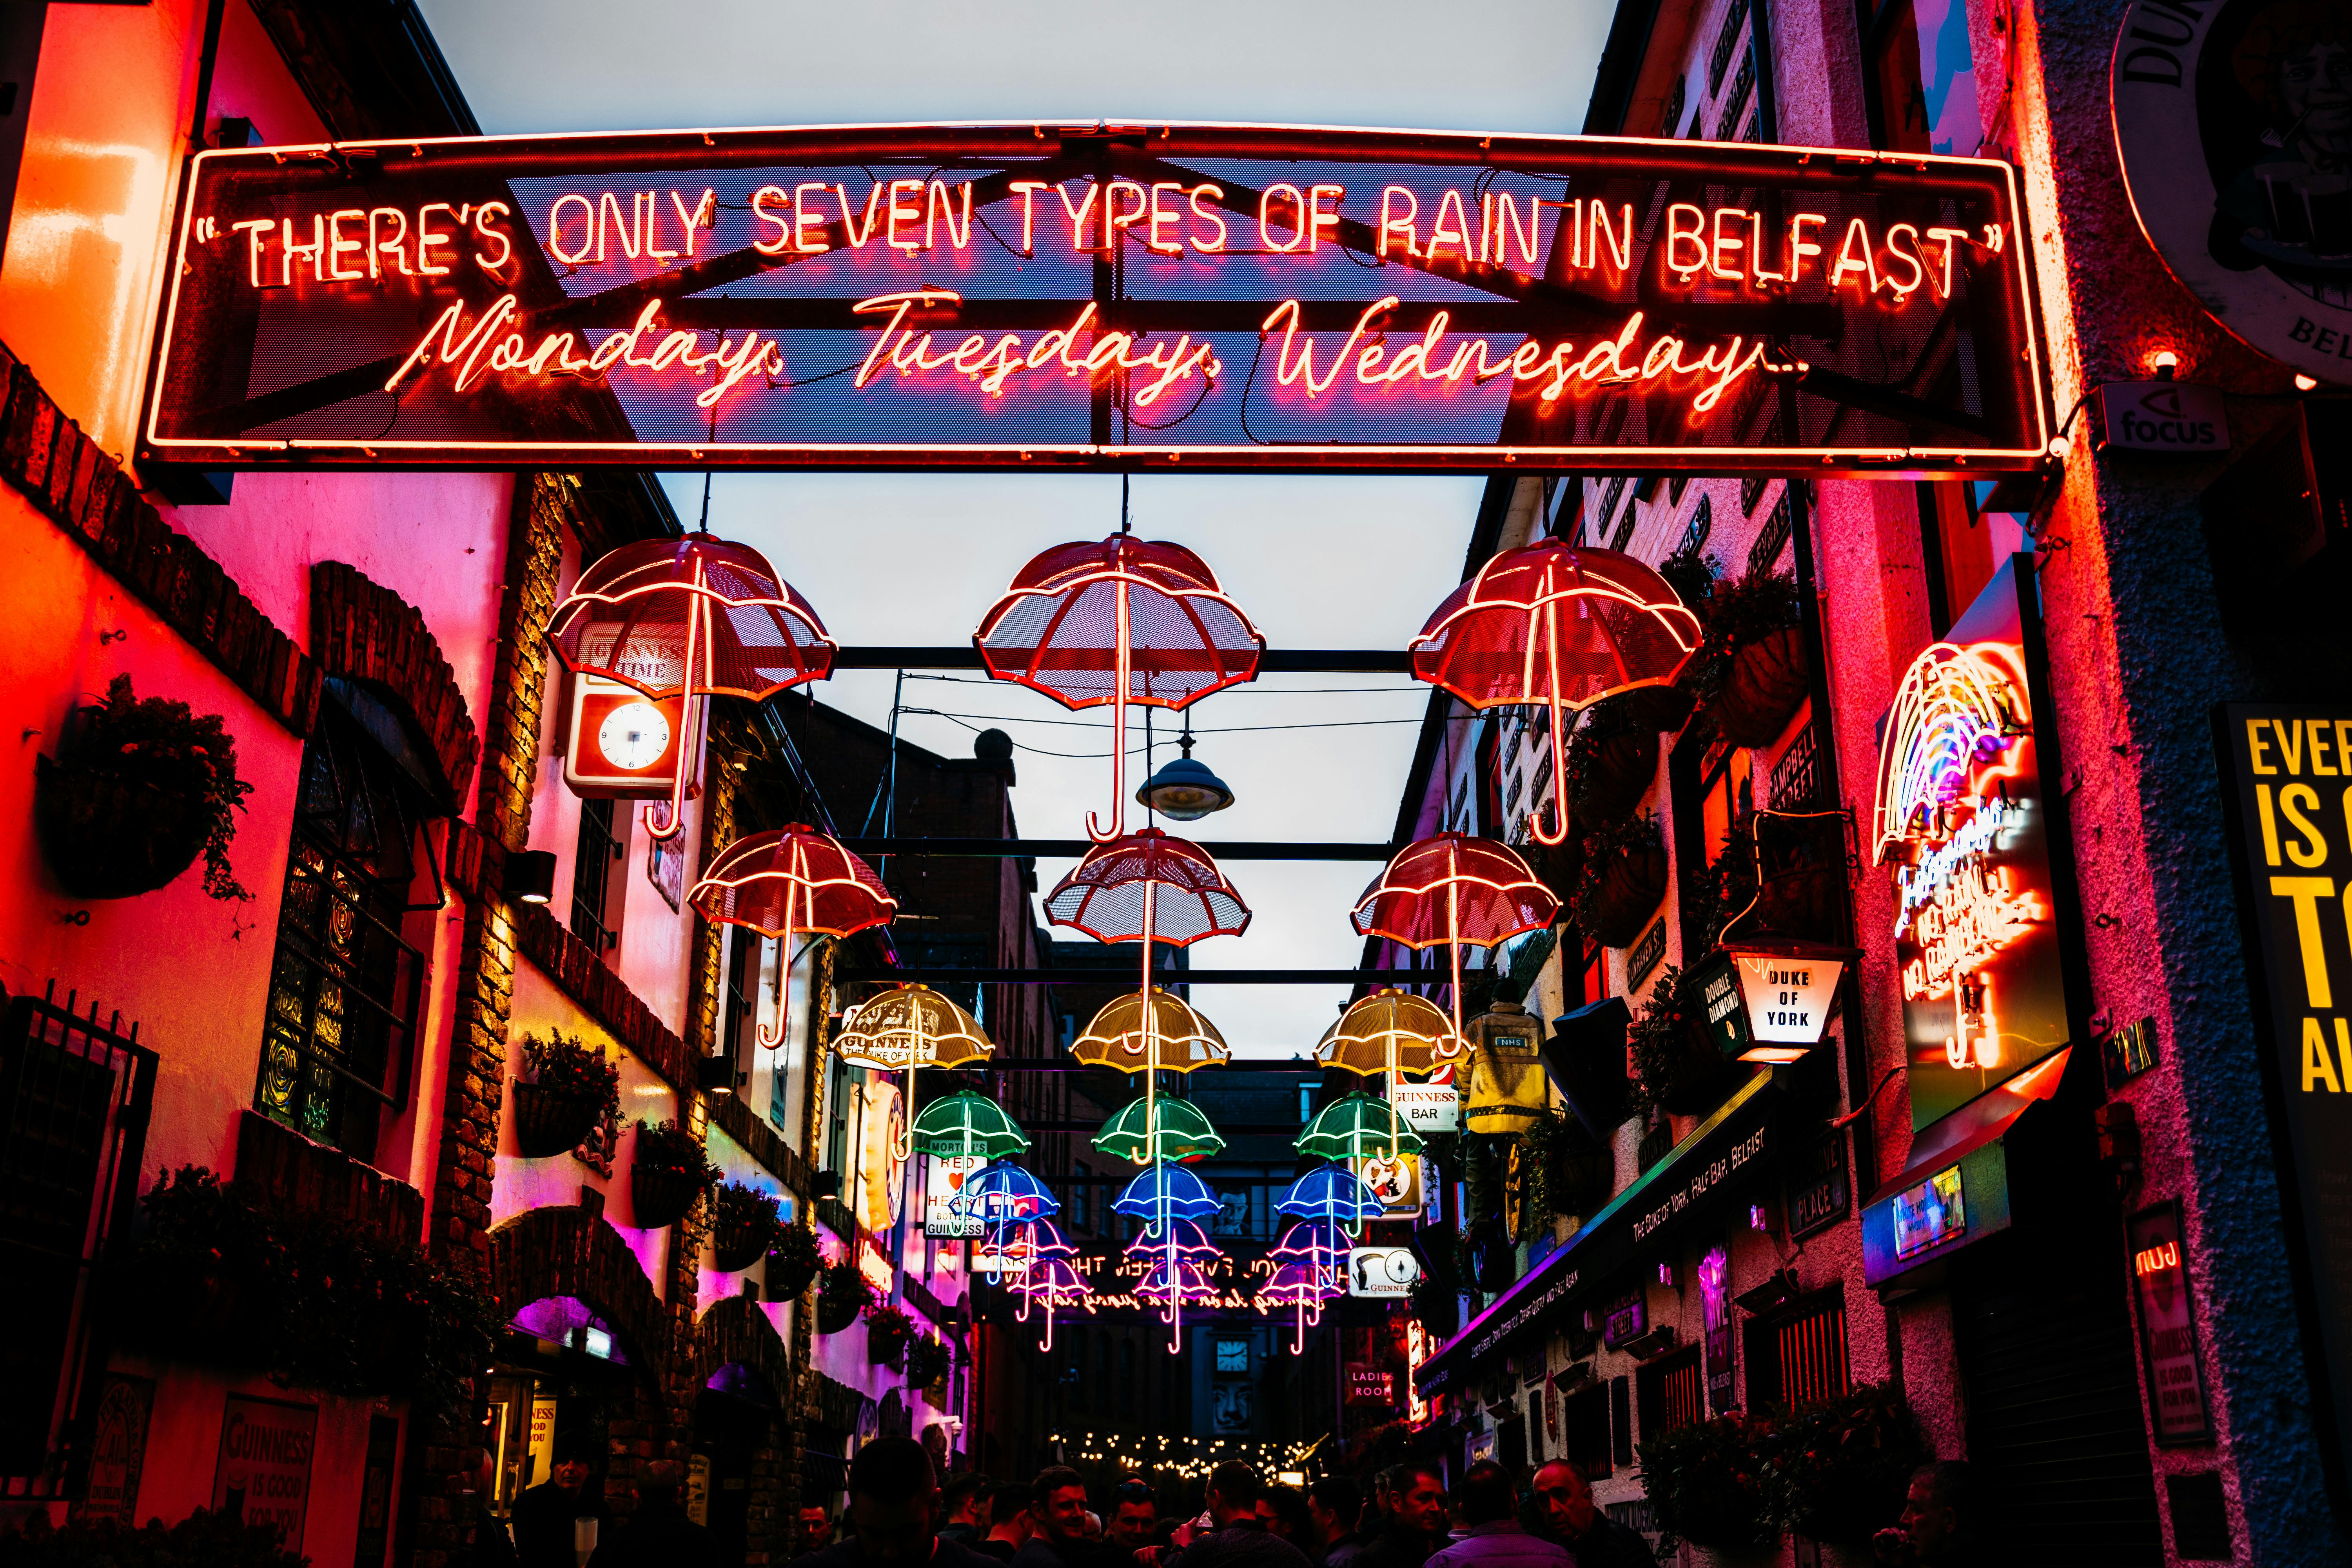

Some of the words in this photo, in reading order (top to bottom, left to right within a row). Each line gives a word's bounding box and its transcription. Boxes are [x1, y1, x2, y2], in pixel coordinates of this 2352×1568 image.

[549, 188, 714, 263] ONLY
[751, 180, 973, 256] SEVEN
[1009, 181, 1227, 255] TYPES
[1258, 185, 1345, 253] OF
[1379, 185, 1541, 265] RAIN
[1572, 199, 1632, 269] IN
[2120, 412, 2216, 446] focus
[1769, 725, 1816, 799] CAMPBELL
[2256, 783, 2328, 868] IS
[1918, 904, 1939, 947] NO
[1943, 864, 1979, 925] RAIN
[1903, 959, 1923, 1000] NO
[1925, 891, 2007, 981] RAINBOWS
[2269, 877, 2352, 1008] T
[1627, 937, 1652, 985] DUNRAVEN
[1705, 973, 1731, 1004] DOUBLE
[1769, 971, 1809, 986] DUKE
[1708, 991, 1739, 1024] DIAMOND
[1779, 992, 1798, 1005] OF
[1767, 1012, 1809, 1026] YORK
[1501, 1038, 1521, 1047] NHS
[891, 1052, 902, 1061] OF
[1411, 1109, 1438, 1119] BAR
[940, 1157, 975, 1169] RED
[1633, 1222, 1645, 1242] THE
[1646, 1208, 1660, 1235] DUKE
[1661, 1201, 1670, 1223] OF
[1691, 1169, 1708, 1202] HALF
[1731, 1126, 1765, 1171] BELFAST
[1798, 1183, 1831, 1229] PLACE
[1370, 1284, 1409, 1292] GUINNE
[2149, 1325, 2194, 1362] GUINNESS
[1353, 1372, 1394, 1381] LADIES
[2159, 1368, 2168, 1386] IS
[2169, 1364, 2192, 1385] GOOD
[1356, 1387, 1392, 1396] ROOM
[2163, 1389, 2179, 1407] FOR
[2179, 1387, 2196, 1405] YOU
[226, 1412, 311, 1467] GUINNESS
[92, 1486, 121, 1499] DUBLIN
[252, 1473, 265, 1497] IS
[267, 1474, 302, 1499] GOOD
[276, 1508, 298, 1532] YOU
